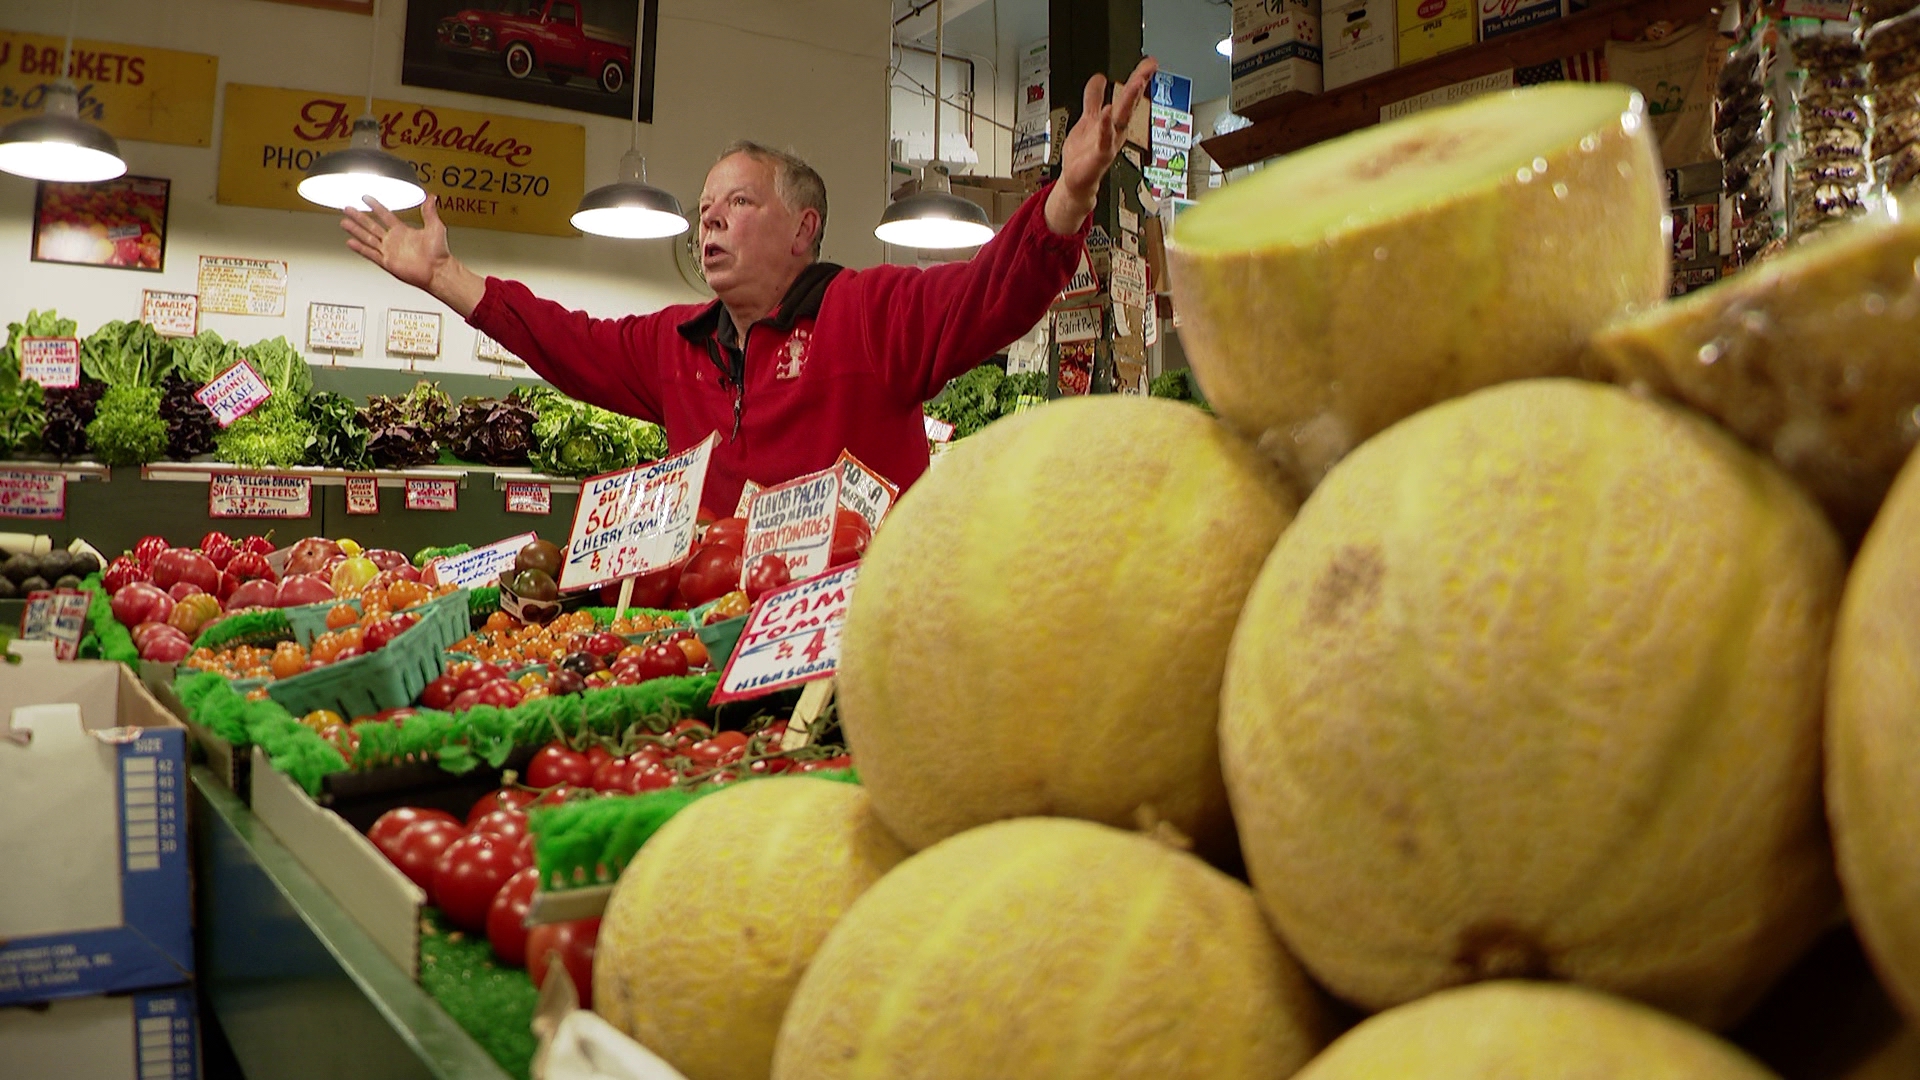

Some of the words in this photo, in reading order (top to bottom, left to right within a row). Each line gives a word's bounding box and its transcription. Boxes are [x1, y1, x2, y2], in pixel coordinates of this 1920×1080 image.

[1264, 16, 1290, 33] APPLES
[1487, 22, 1501, 33] The
[1503, 13, 1532, 28] World's
[1533, 6, 1558, 19] Finest
[1297, 46, 1320, 61] STA
[1446, 73, 1509, 100] BIRTHDAY
[293, 99, 403, 150] Frt
[412, 109, 533, 167] Produce
[262, 145, 323, 172] PHO
[441, 166, 550, 197] 622-1370
[315, 304, 349, 315] FRESH
[310, 319, 358, 332] SPINACH
[251, 486, 299, 498] PEPPERS
[843, 459, 883, 505] ROA
[752, 484, 793, 520] FLAVOR
[572, 526, 625, 556] CHERRY
[628, 502, 691, 537] TOMAOES
[779, 513, 832, 546] TOMATOES
[761, 587, 846, 626] CAM
[745, 607, 848, 645] TOMA
[134, 738, 163, 753] SIZE
